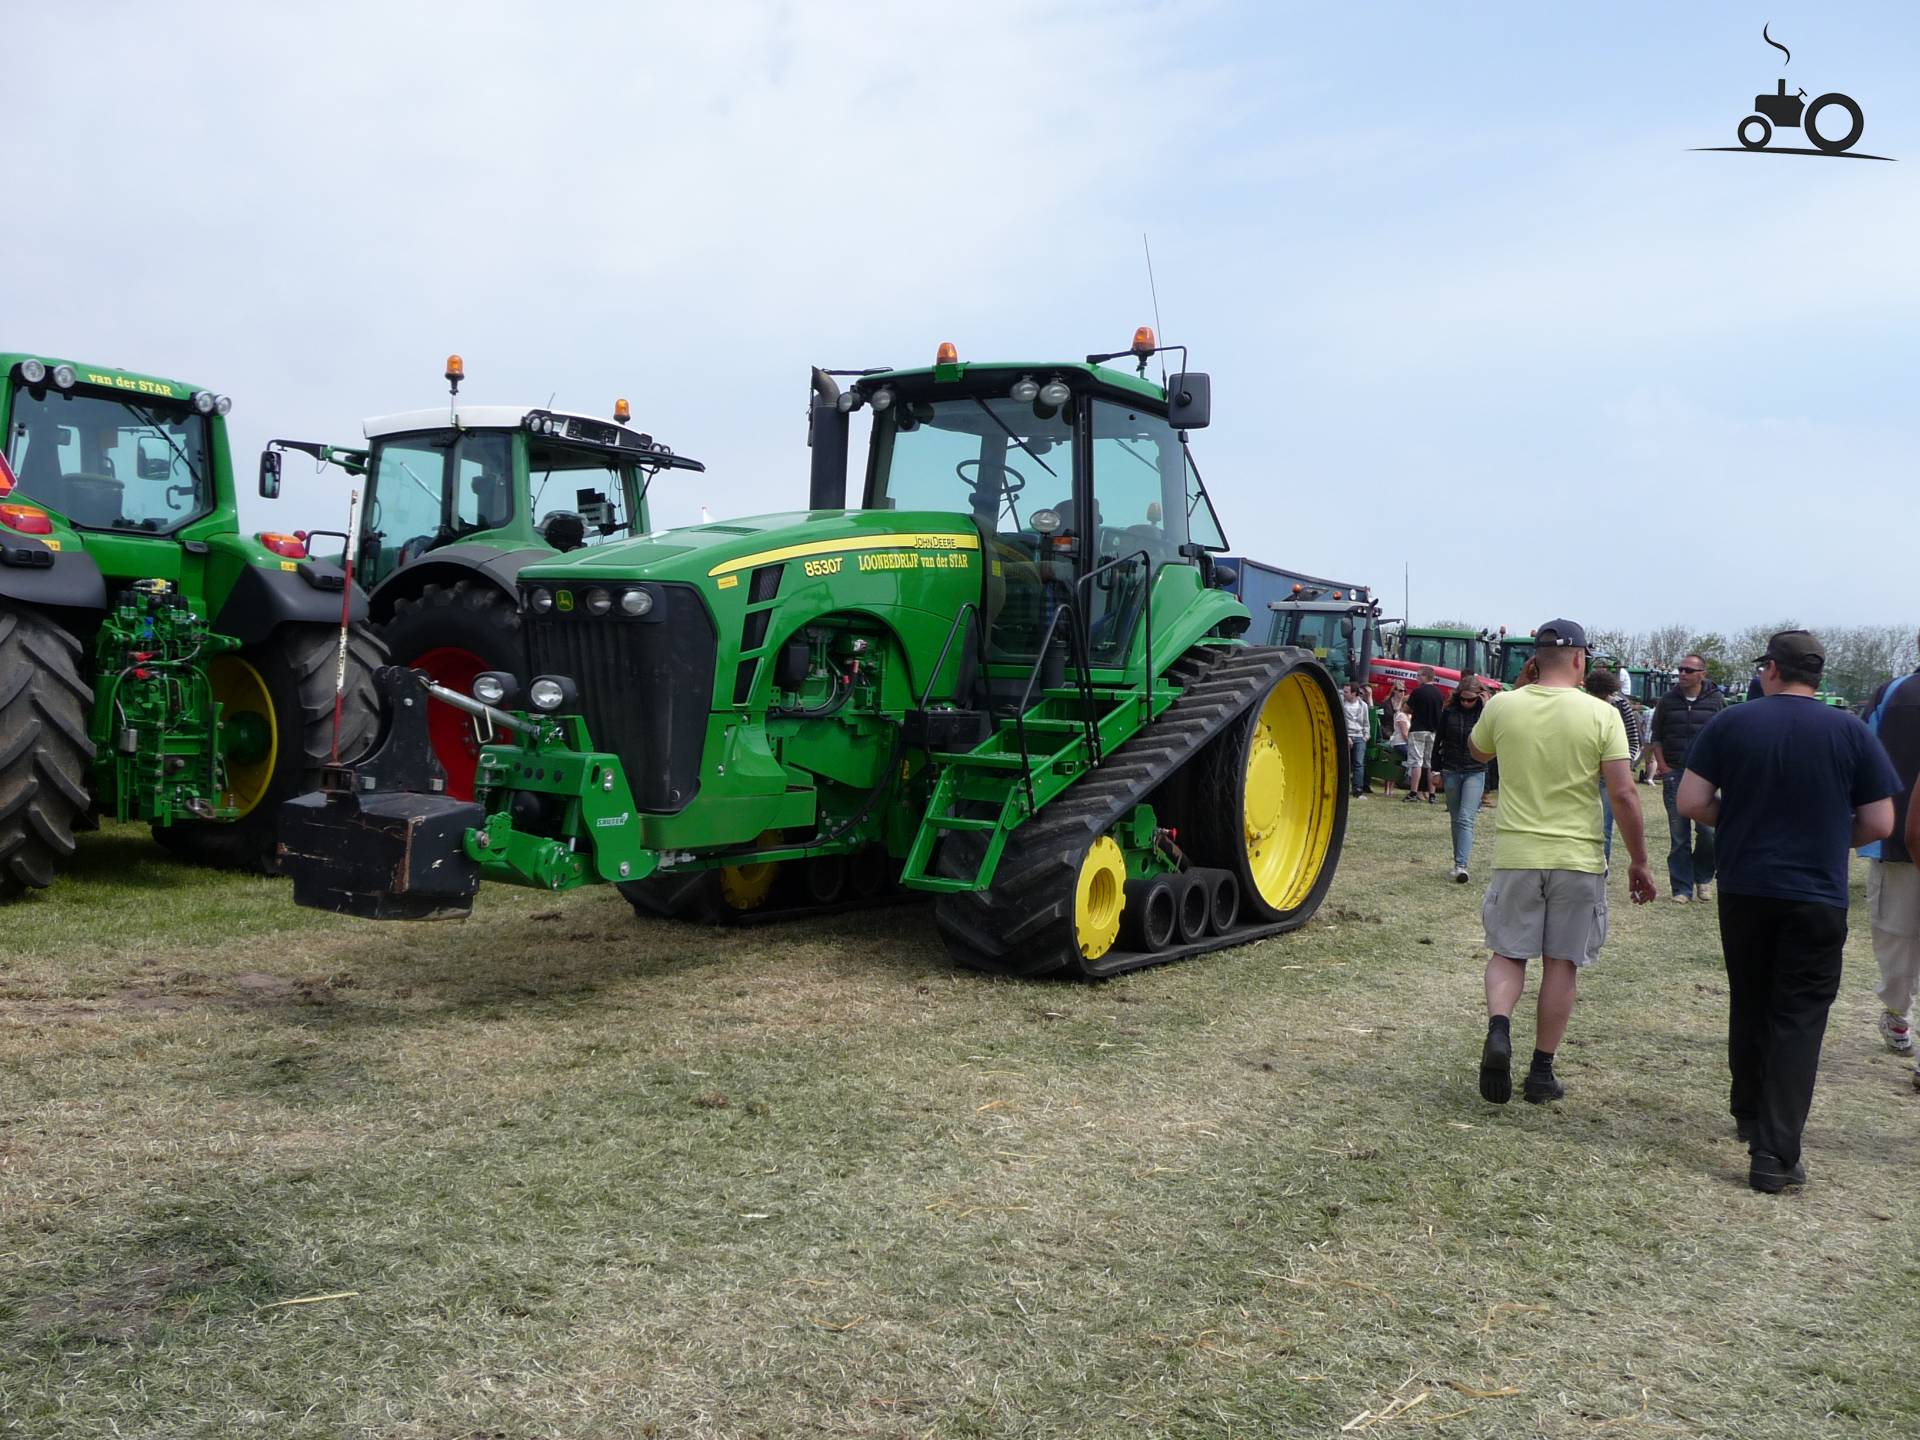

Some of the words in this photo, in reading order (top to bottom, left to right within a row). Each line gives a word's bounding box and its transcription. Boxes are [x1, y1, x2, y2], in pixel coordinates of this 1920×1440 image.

[88, 374, 112, 385] van
[116, 376, 136, 389] der
[138, 380, 172, 397] STAR
[914, 535, 933, 548] JOHN
[804, 557, 843, 577] 8530T
[858, 553, 918, 571] LOONBEDRIJF
[920, 555, 935, 568] van
[936, 553, 948, 568] der
[948, 554, 969, 568] STAR
[1385, 669, 1408, 678] MASSEY
